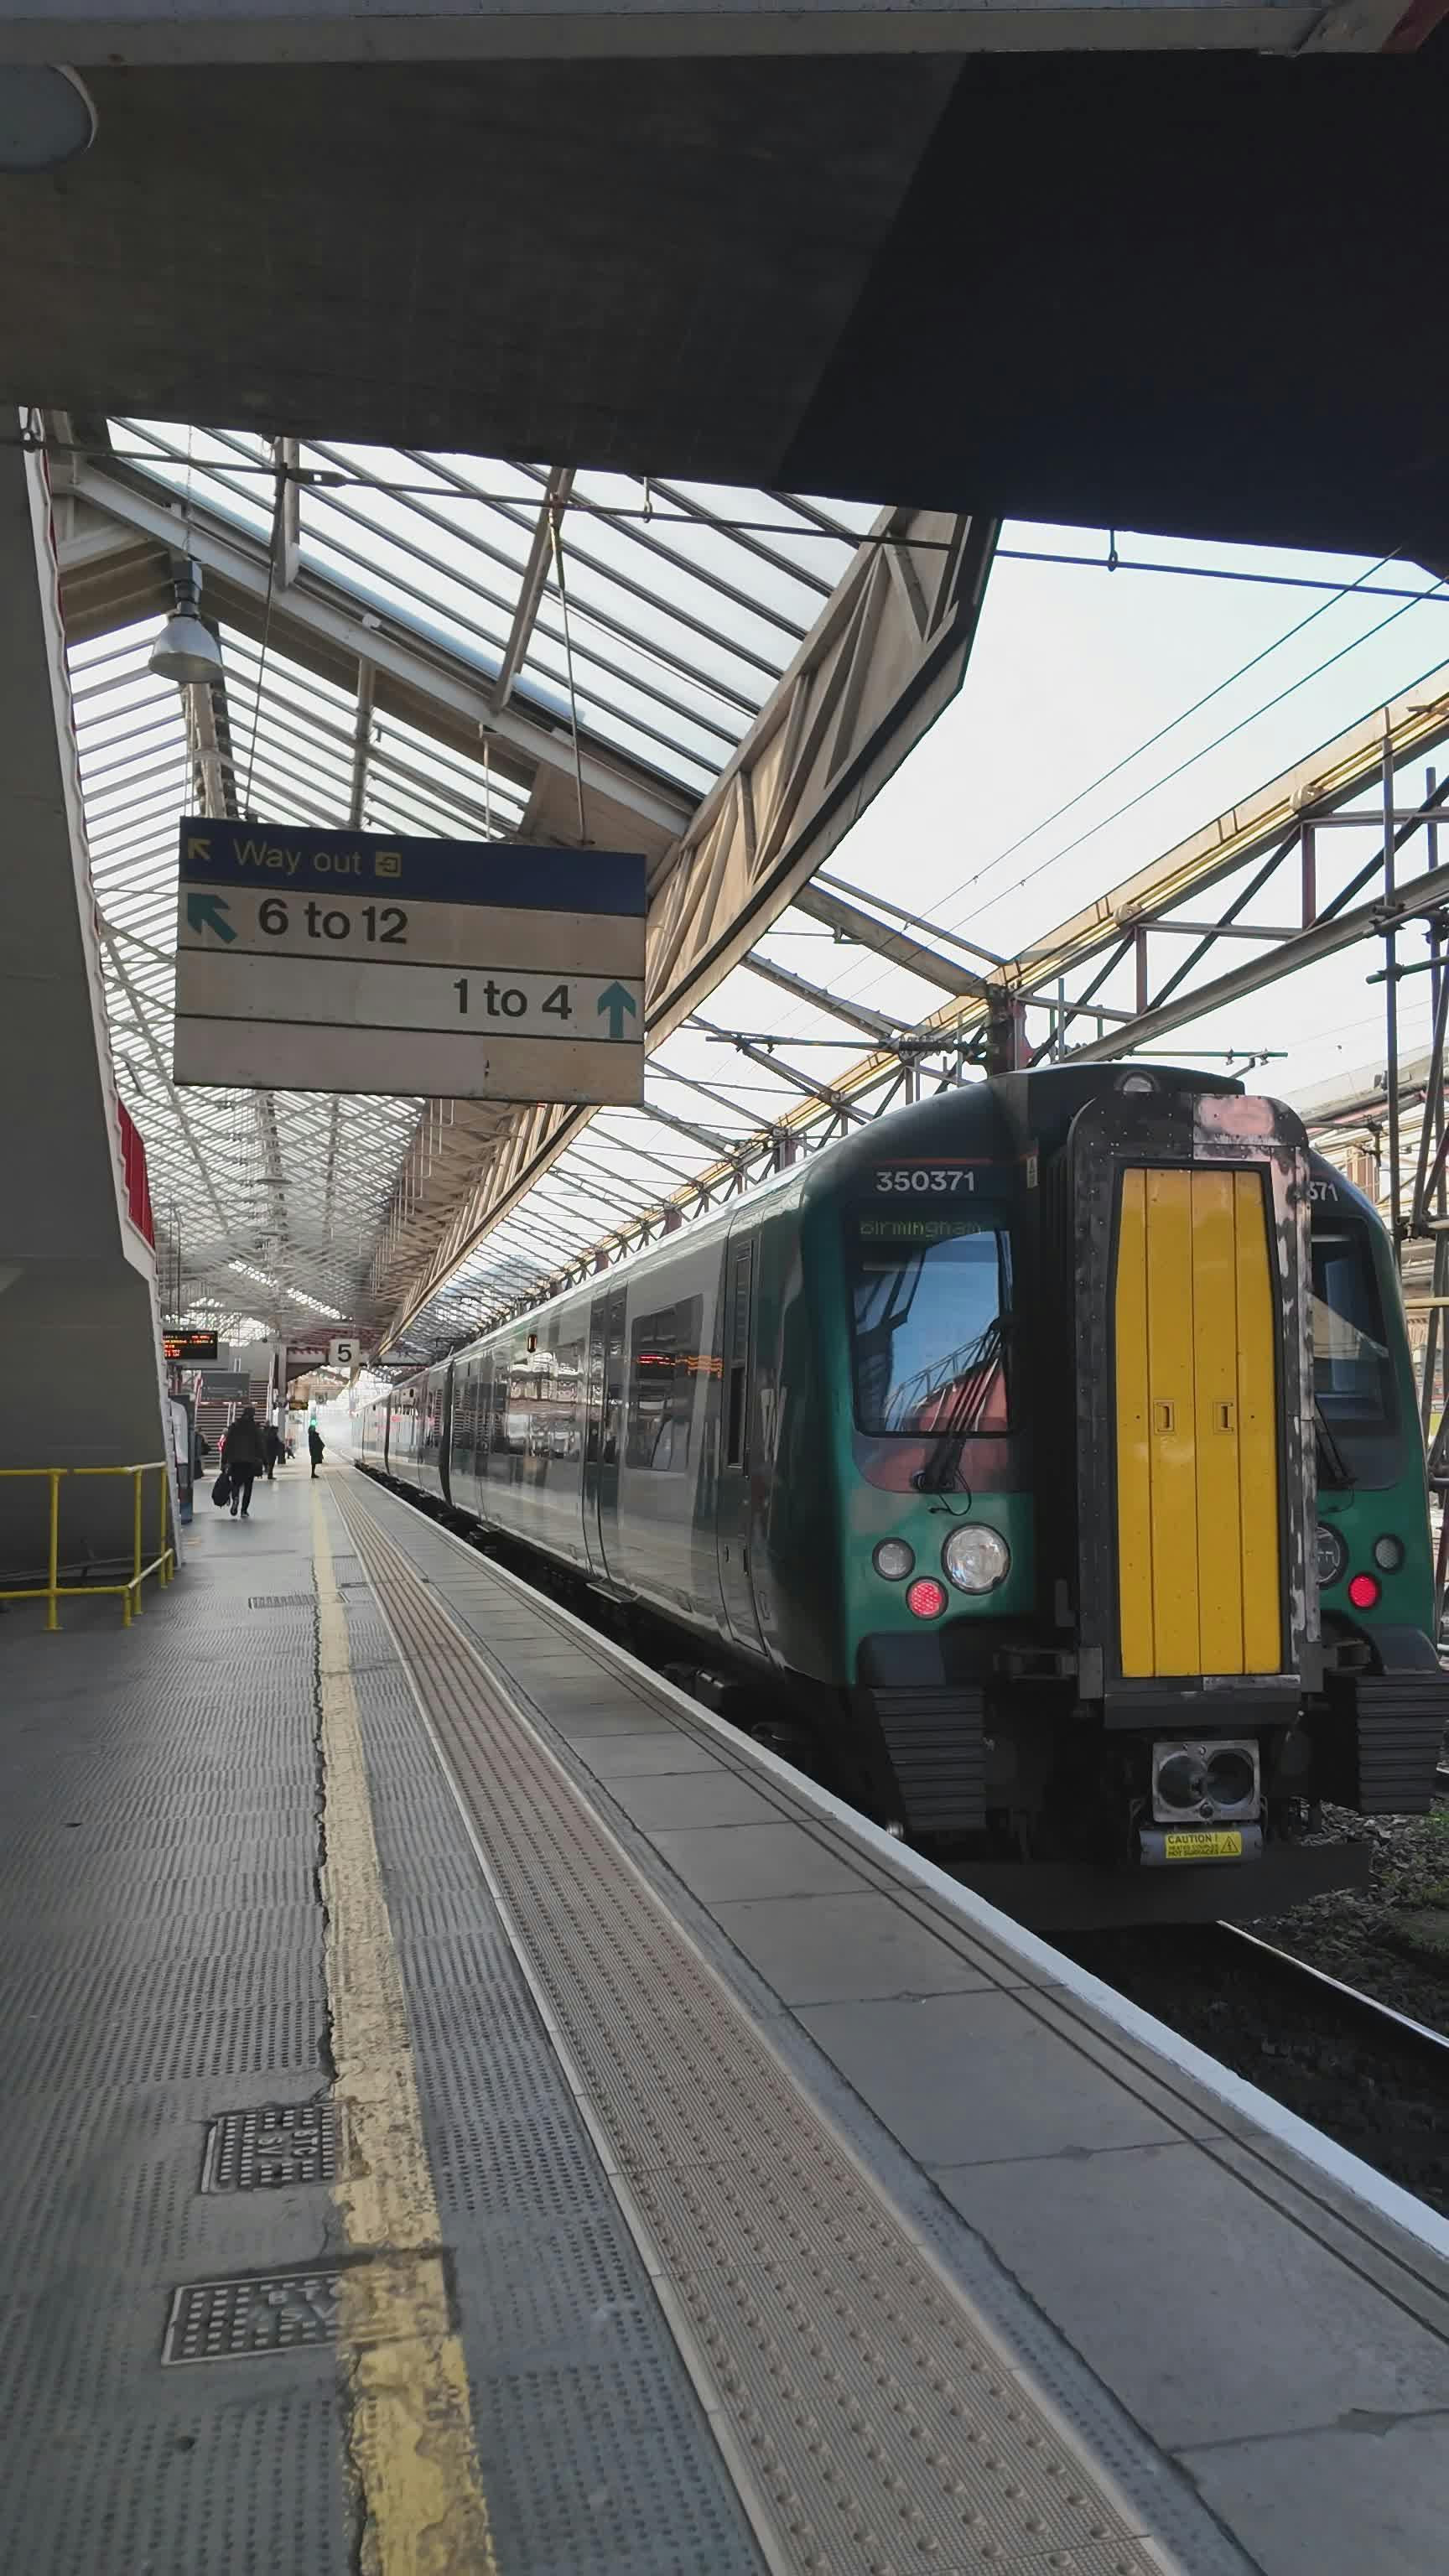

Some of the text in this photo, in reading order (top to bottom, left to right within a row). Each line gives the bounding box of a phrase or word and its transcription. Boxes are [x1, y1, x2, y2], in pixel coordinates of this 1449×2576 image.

[233, 838, 361, 875] Way out
[258, 898, 408, 944] 6 to 12
[453, 979, 572, 1021] 1 to 4
[875, 1171, 975, 1192] 350371
[337, 1343, 352, 1363] 5
[1167, 1834, 1213, 1844] CAUTION
